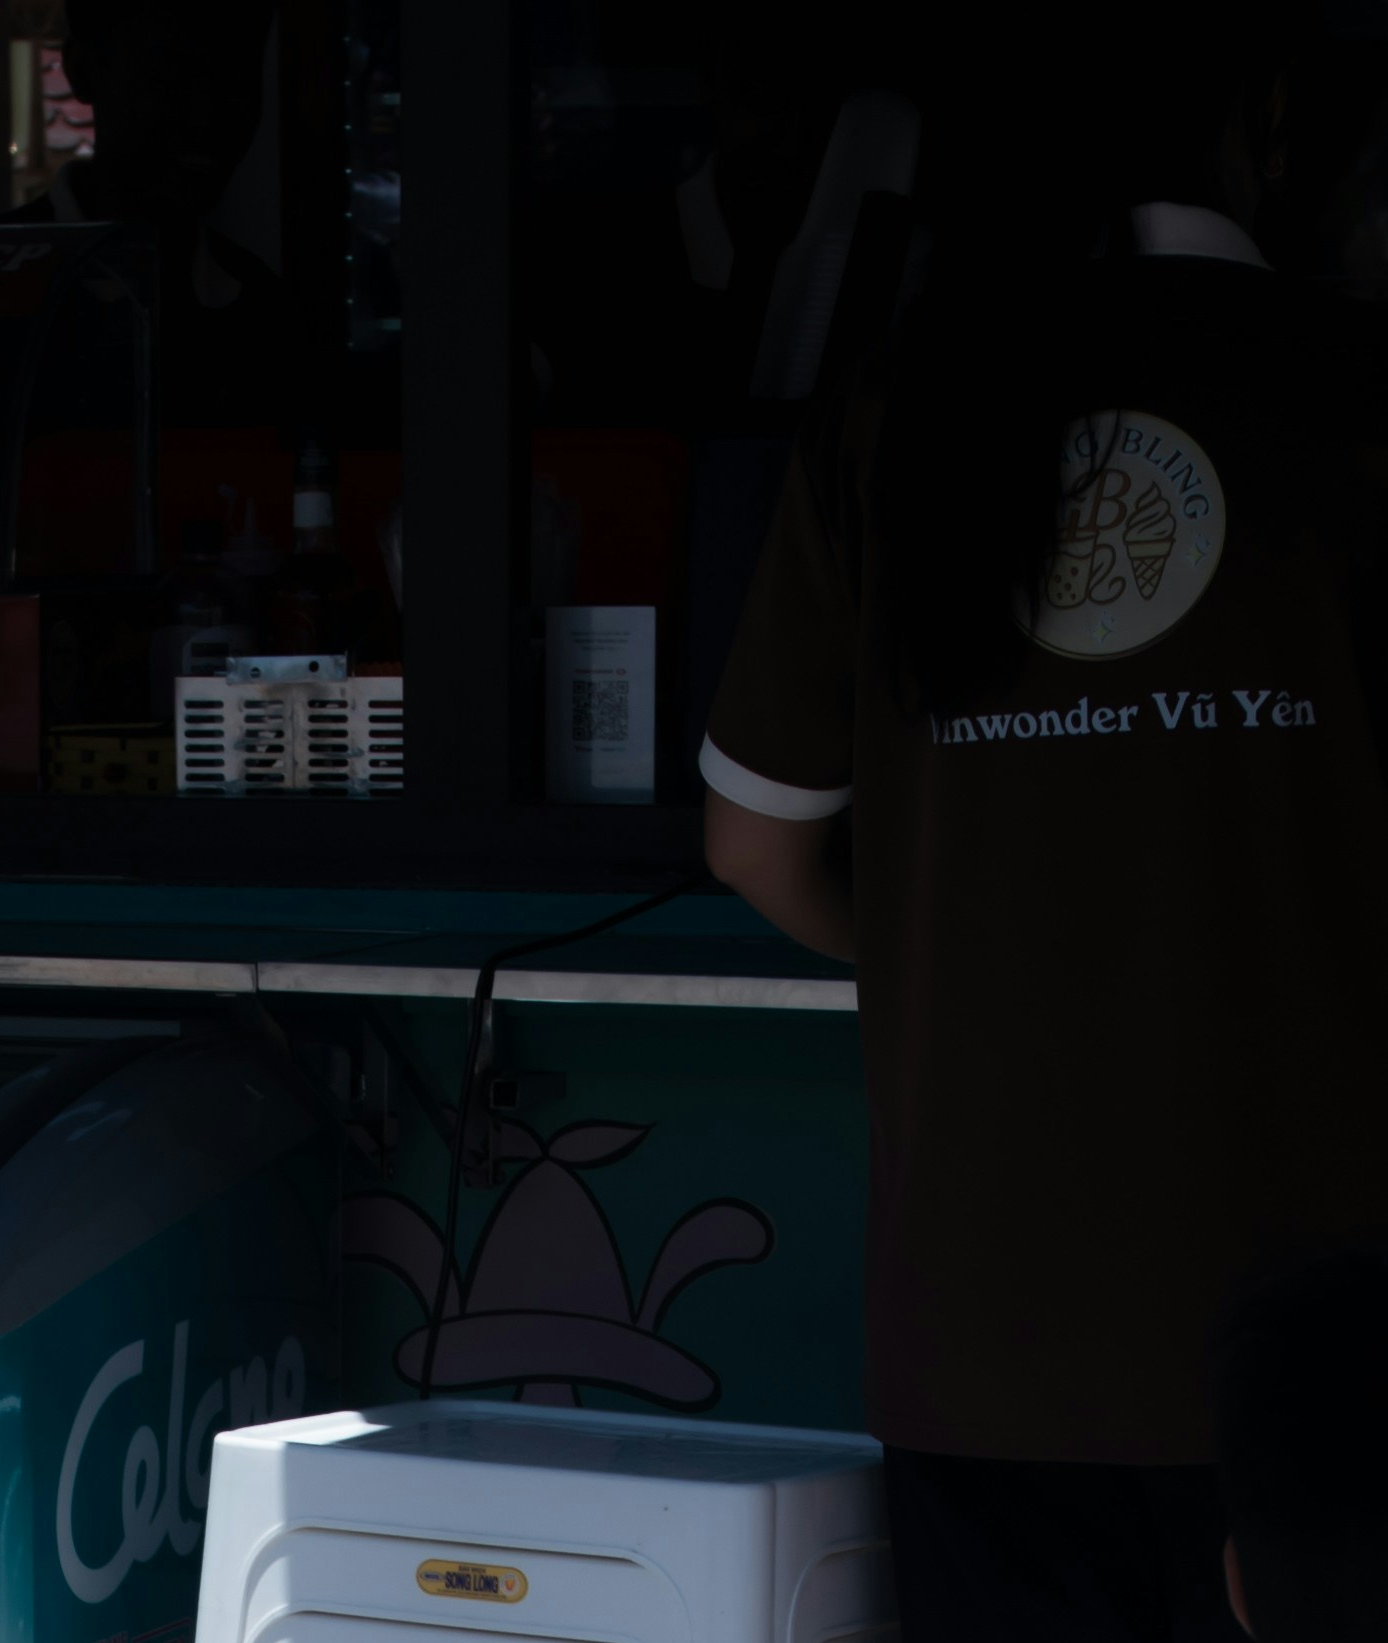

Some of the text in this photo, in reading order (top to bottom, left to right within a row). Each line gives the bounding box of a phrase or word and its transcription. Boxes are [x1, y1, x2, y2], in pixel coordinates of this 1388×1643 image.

[1123, 428, 1209, 519] BLING
[1151, 691, 1219, 730] Vũ
[1232, 690, 1316, 729] Yên
[445, 1571, 471, 1591] SONG
[473, 1574, 499, 1594] LONG
